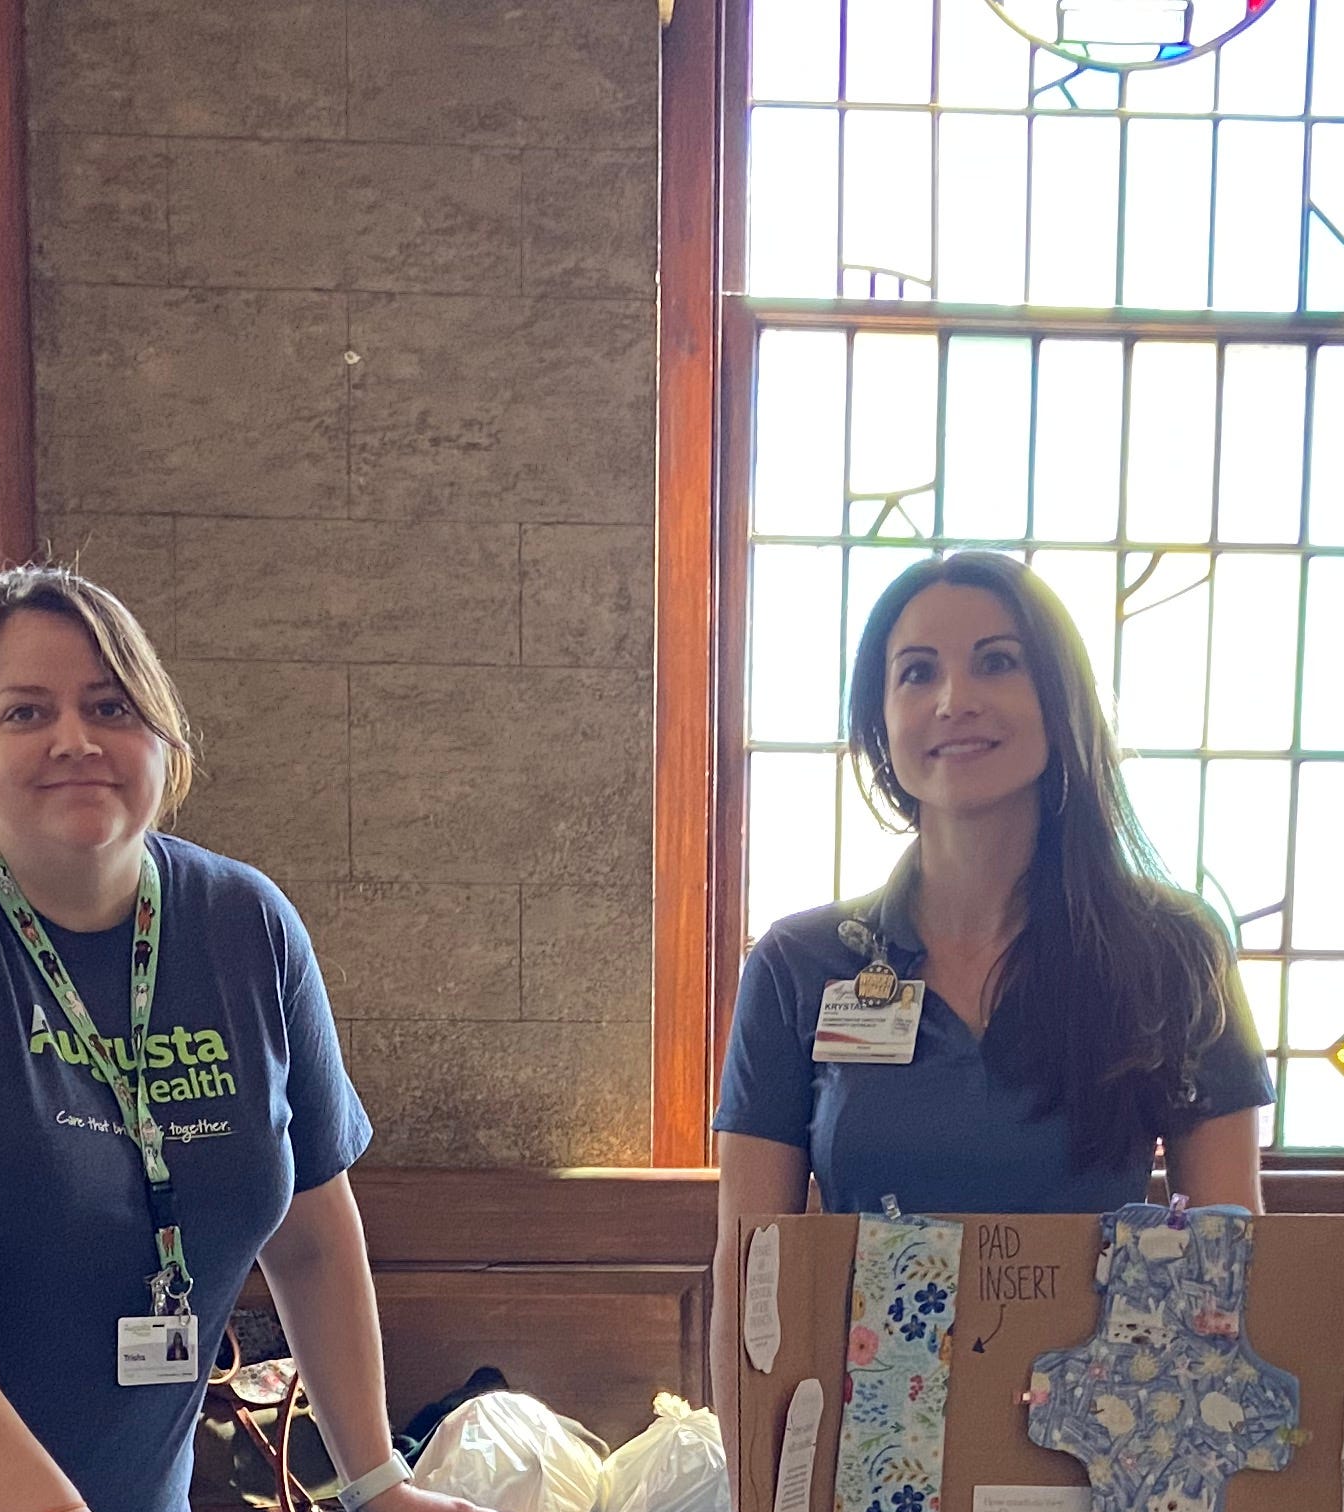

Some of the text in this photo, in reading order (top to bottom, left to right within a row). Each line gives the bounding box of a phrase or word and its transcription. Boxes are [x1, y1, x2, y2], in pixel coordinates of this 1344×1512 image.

[56, 1110, 85, 1127] Care
[88, 1116, 110, 1133] that
[169, 1118, 232, 1143] together.
[979, 1224, 1020, 1260] PAD
[979, 1265, 1060, 1301] INSERT
